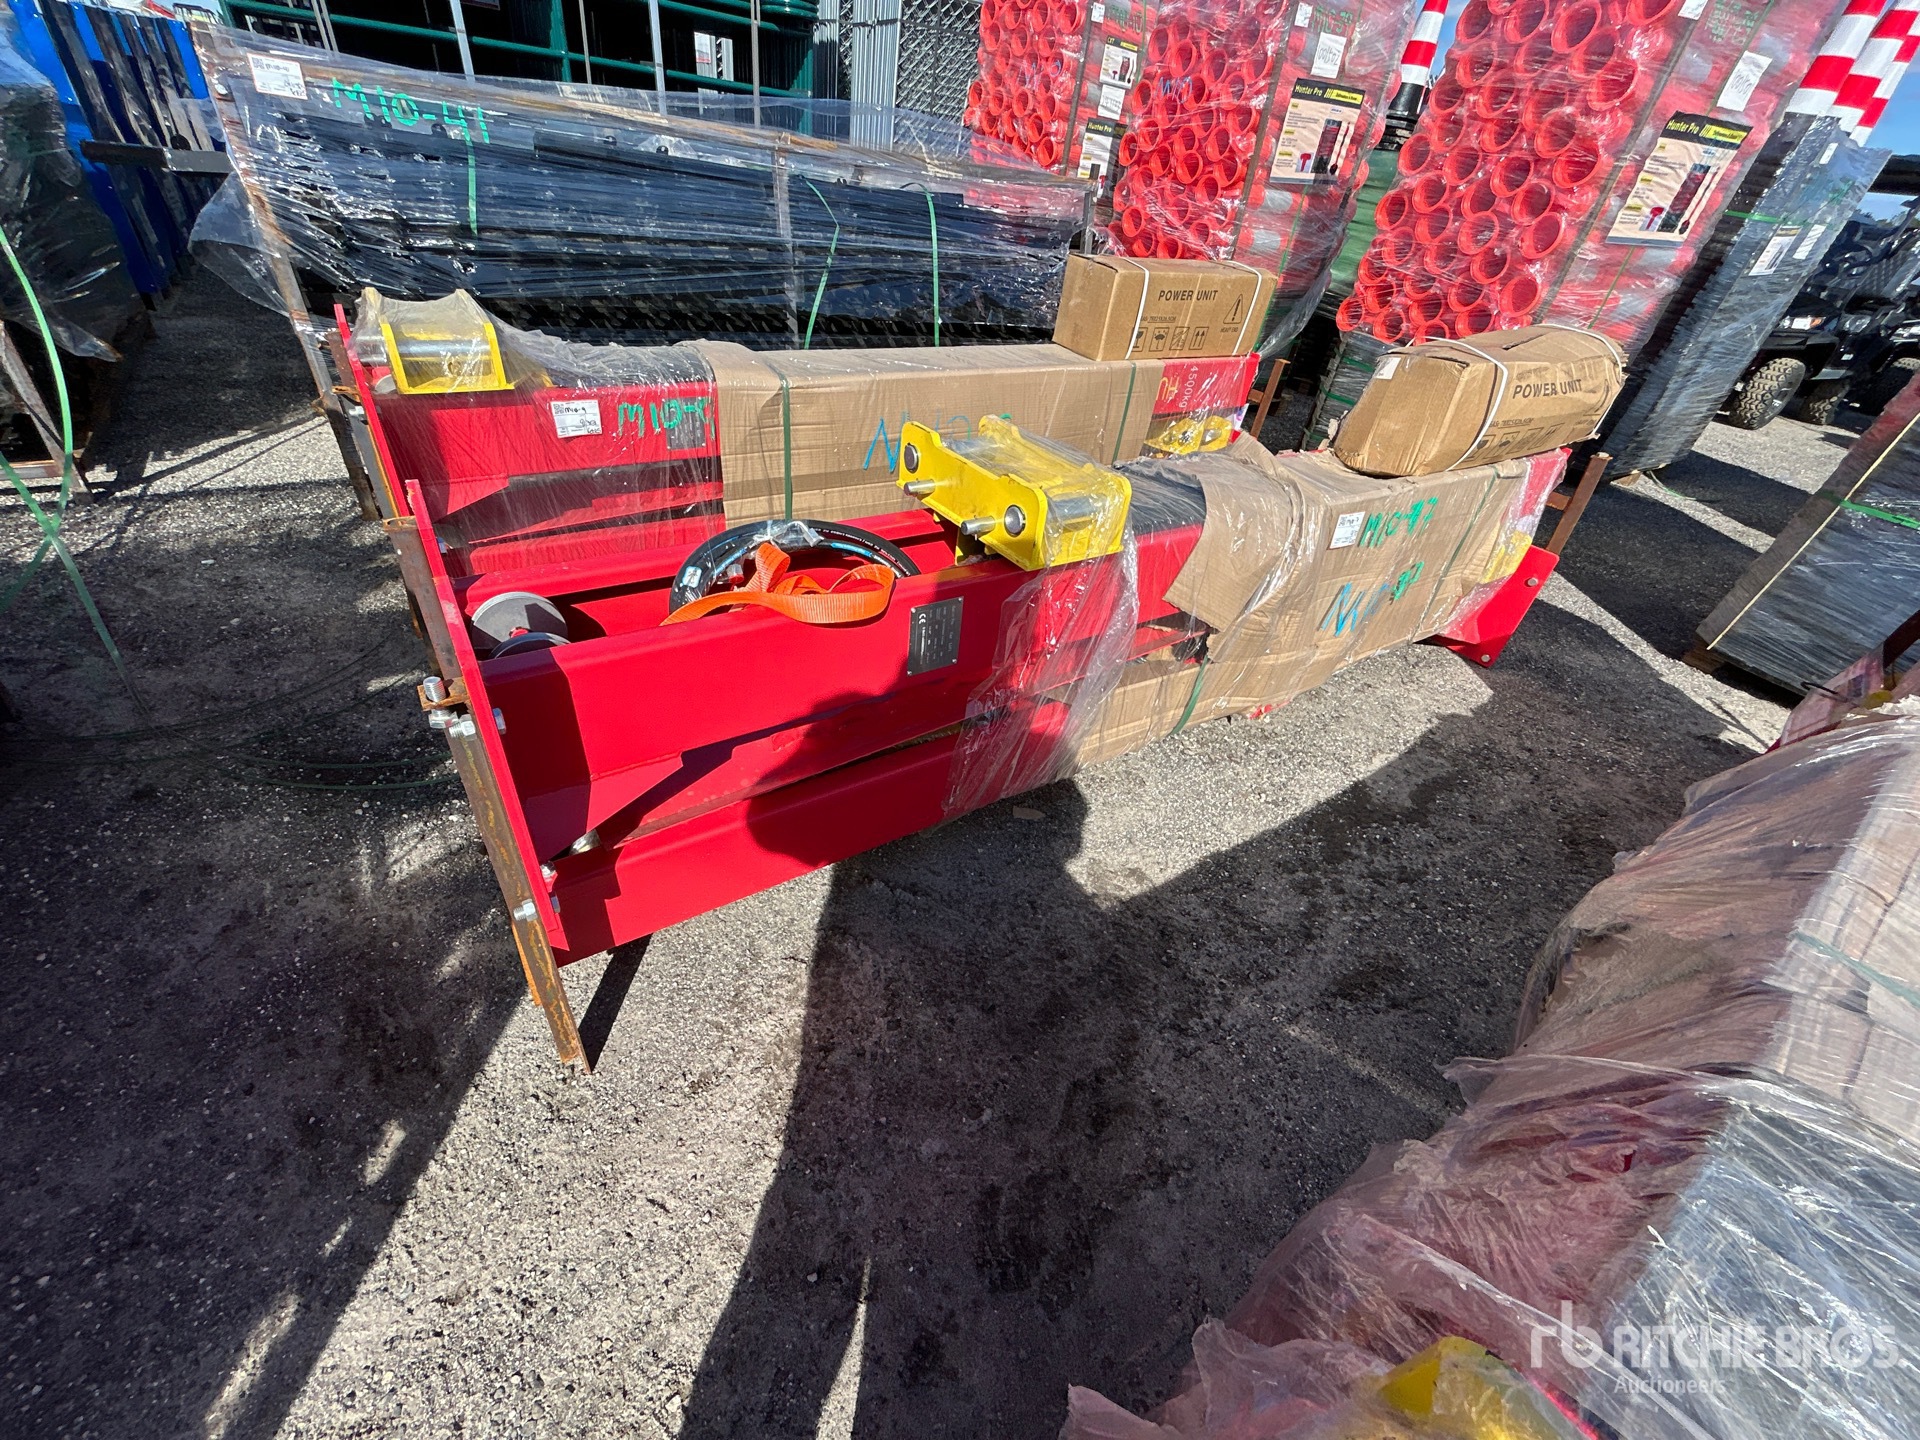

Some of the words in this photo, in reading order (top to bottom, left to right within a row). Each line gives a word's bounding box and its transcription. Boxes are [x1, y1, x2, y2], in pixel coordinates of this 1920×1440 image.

[1294, 85, 1313, 95] Hunter
[1313, 87, 1323, 97] Pro
[331, 77, 490, 144] M10-41
[1087, 122, 1104, 131] Hunter
[1104, 125, 1112, 133] Pro
[1667, 119, 1689, 133] Hunter
[1687, 122, 1700, 134] Pro
[1158, 290, 1193, 302] POWER
[1195, 289, 1219, 301] UNIT
[1179, 366, 1198, 408] 4500kg
[1512, 382, 1558, 399] POWER
[1559, 379, 1583, 395] UNIT
